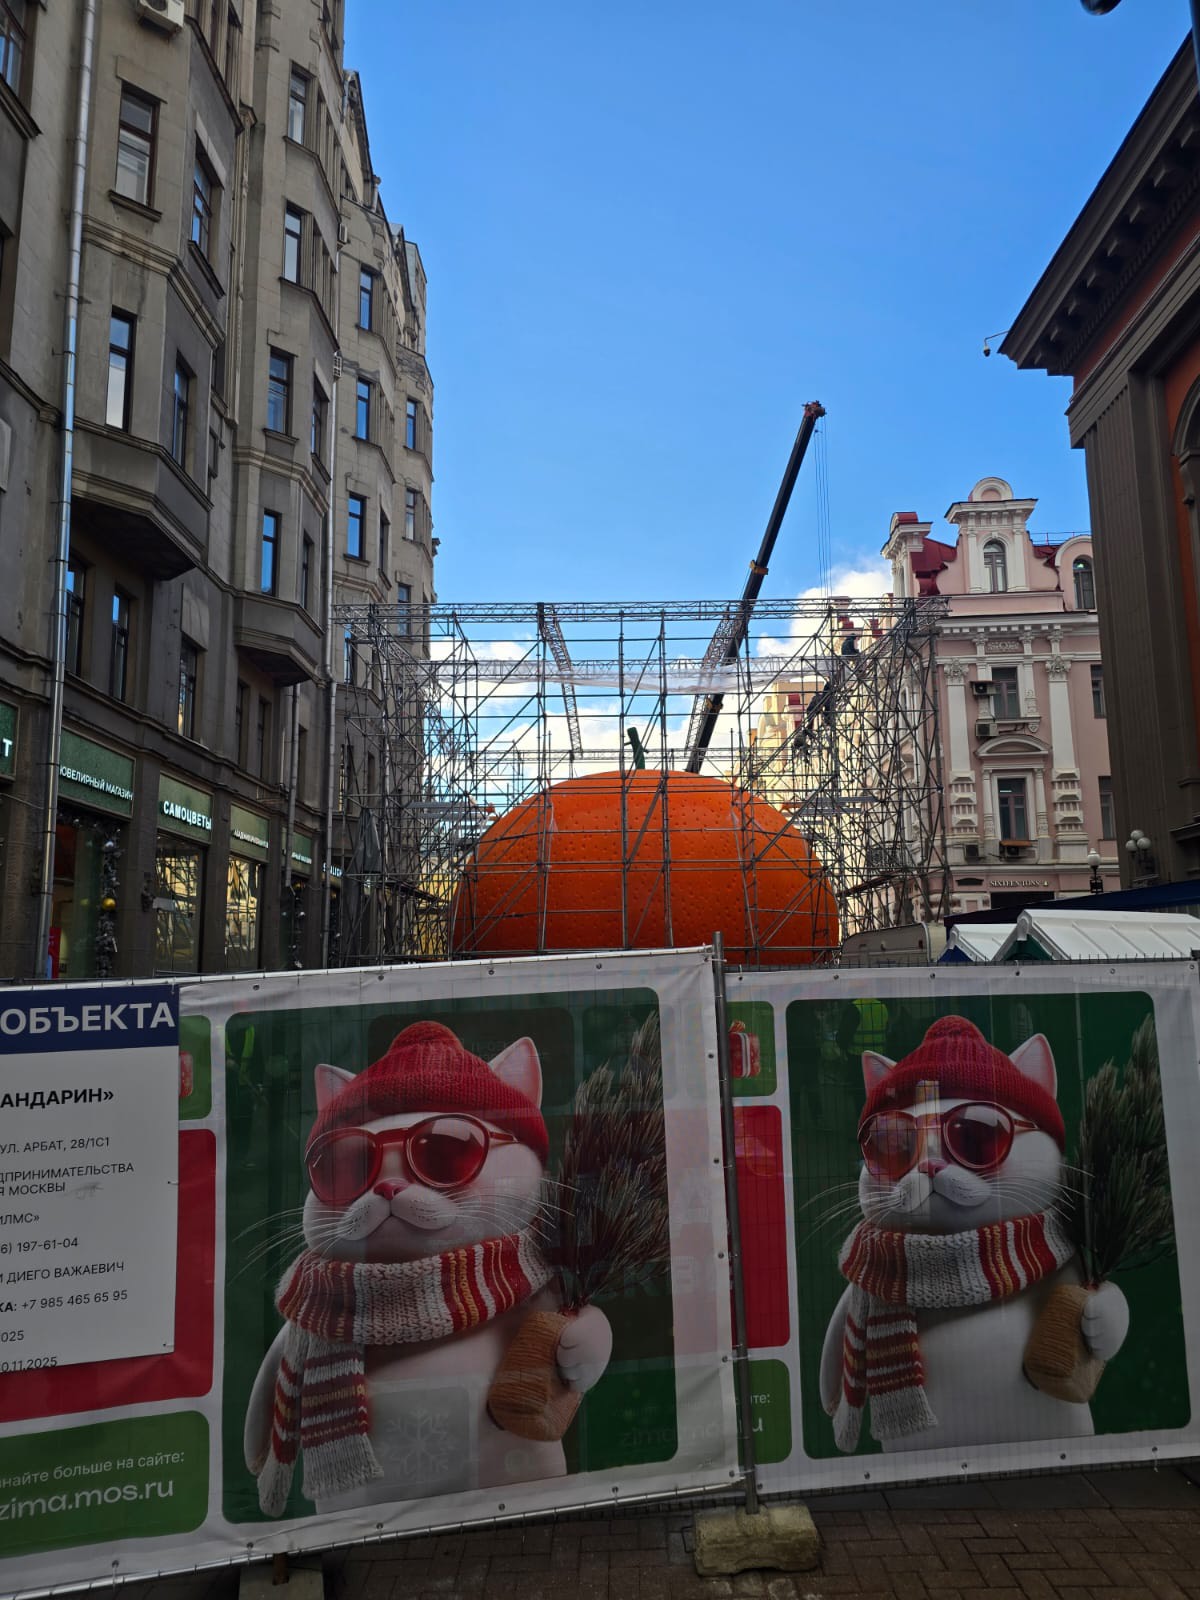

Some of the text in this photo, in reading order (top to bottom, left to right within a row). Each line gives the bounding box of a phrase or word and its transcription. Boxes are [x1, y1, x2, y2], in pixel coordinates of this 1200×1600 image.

[60, 765, 133, 801] ЮВЕЛИРНЫЙ МАГАЗИН
[163, 800, 212, 830] САМОЦВЕТЫ
[0, 1002, 175, 1036] ОБЪЕКТА
[0, 1088, 114, 1110] АНДАРИН»
[23, 1140, 67, 1153] АРБАТ,
[9, 1183, 66, 1197] МОСКВЫ
[17, 1238, 78, 1253] 197-61-04
[7, 1268, 50, 1284] ДИЕГО
[54, 1262, 125, 1279] ВАЖАЕВИЧ
[21, 1300, 36, 1310] +7
[40, 1296, 64, 1309] 985
[67, 1293, 91, 1307] 465
[94, 1291, 109, 1304] 65
[112, 1290, 128, 1302] 95
[0, 1452, 185, 1489] найте больше на сайте:
[0, 1479, 174, 1520] zima.mos.ru
